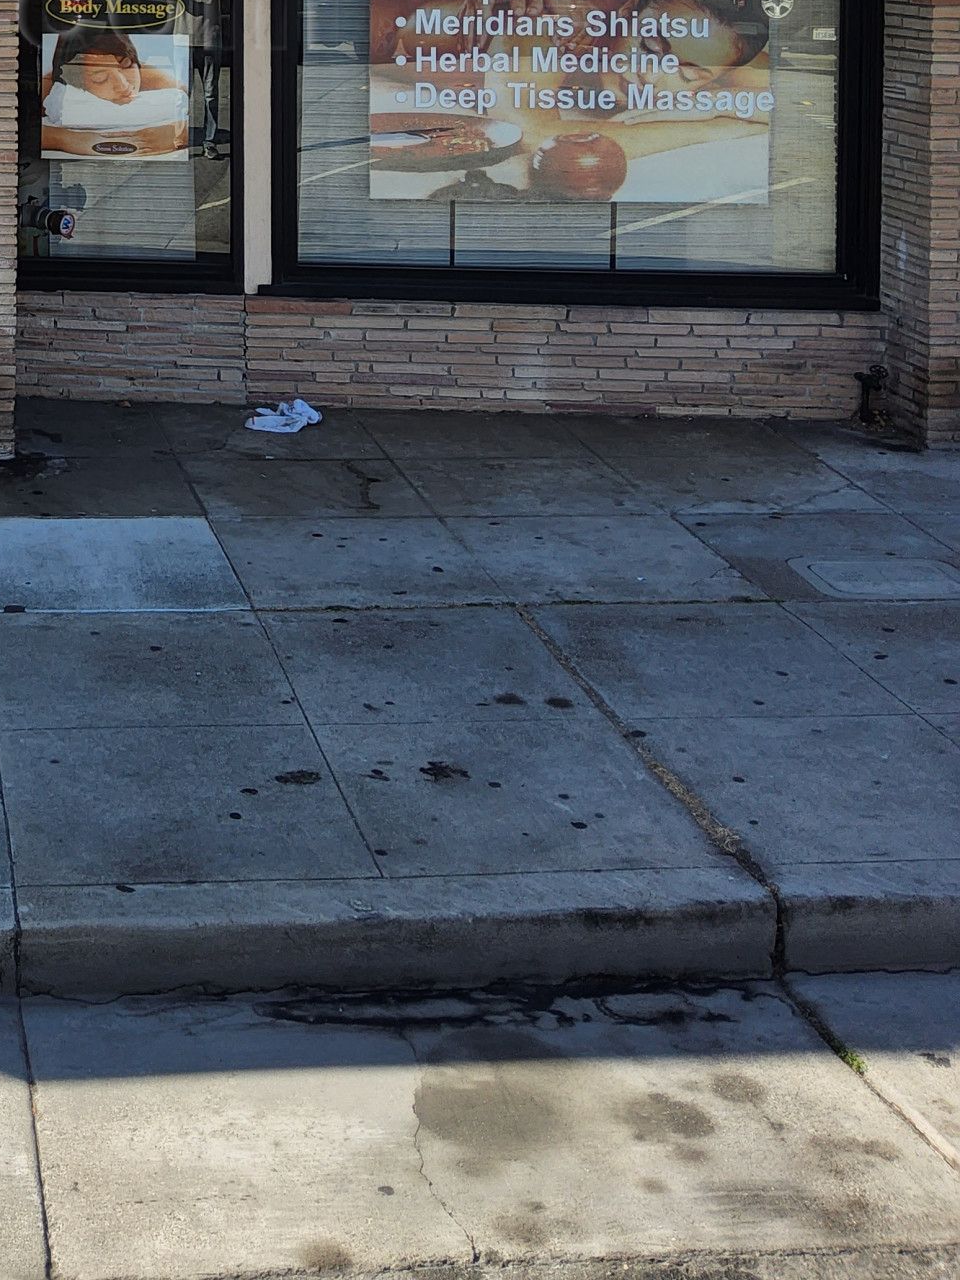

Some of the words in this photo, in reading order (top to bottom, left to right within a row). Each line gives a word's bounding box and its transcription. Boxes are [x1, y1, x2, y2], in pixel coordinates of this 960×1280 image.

[414, 7, 574, 38] Meridians
[585, 8, 710, 39] Shiatsu
[415, 45, 520, 74] Herbal
[532, 45, 680, 74] Medicine
[414, 83, 497, 115] Deep
[511, 83, 616, 111] Tissue
[627, 85, 775, 115] Massage
